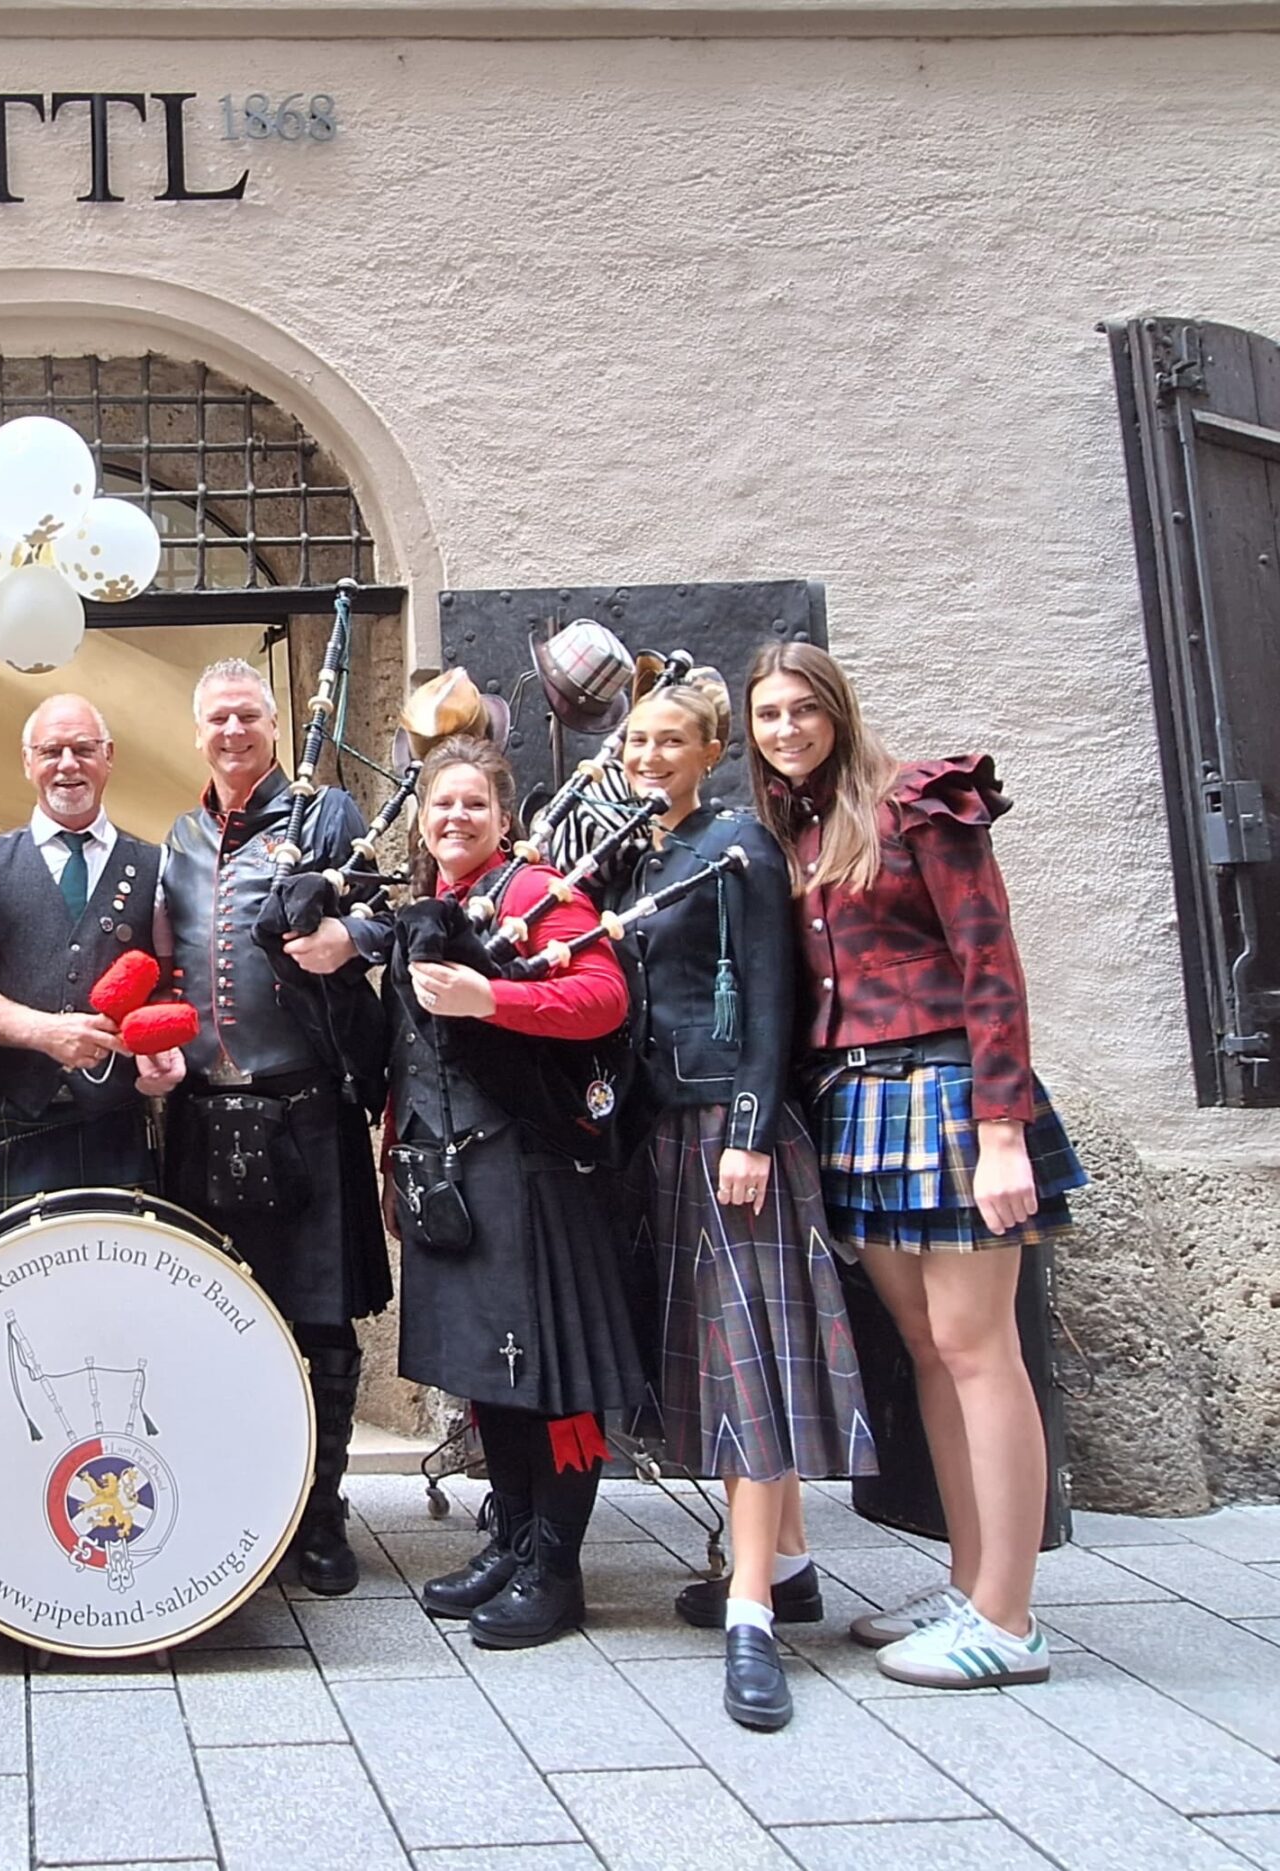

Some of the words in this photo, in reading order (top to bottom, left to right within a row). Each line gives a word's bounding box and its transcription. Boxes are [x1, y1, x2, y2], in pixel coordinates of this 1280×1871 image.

[220, 93, 336, 141] 1868
[97, 1240, 147, 1266] Lion
[154, 1251, 202, 1288] Pipe
[202, 1279, 256, 1335] Band
